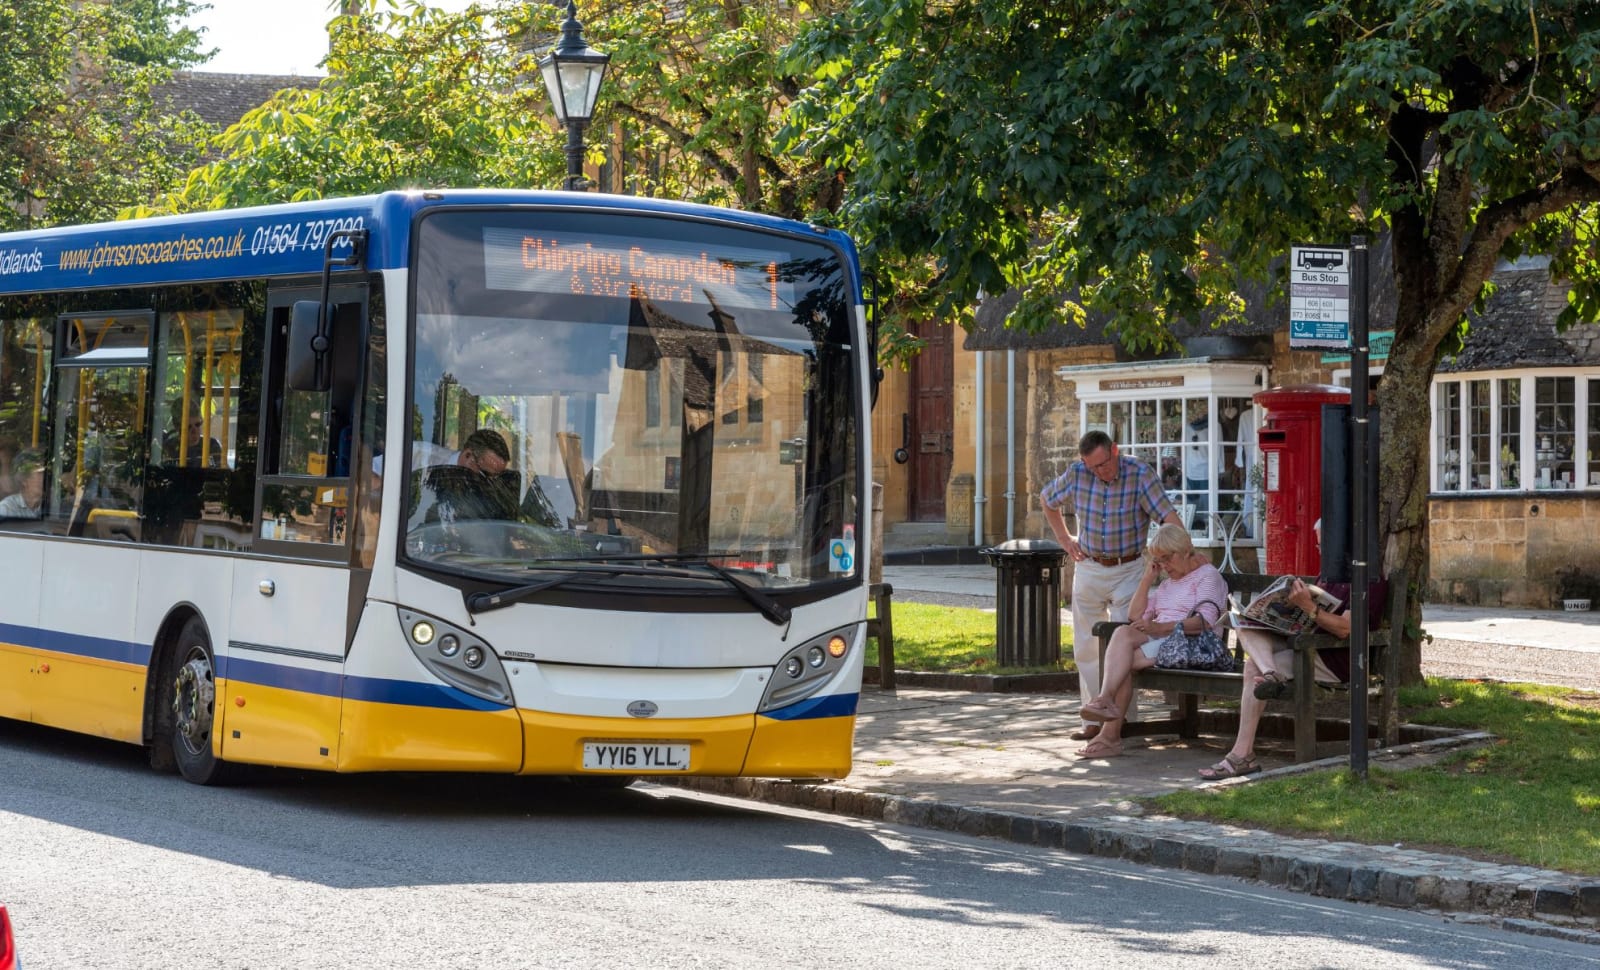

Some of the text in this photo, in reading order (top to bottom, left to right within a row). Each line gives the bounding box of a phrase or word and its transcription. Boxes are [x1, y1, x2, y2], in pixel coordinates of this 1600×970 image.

[59, 228, 246, 275] www.johnsonscoaches.co.uk
[251, 222, 302, 256] 01564
[521, 236, 736, 286] Chipping Campden
[571, 275, 693, 304] & Stratford
[766, 260, 777, 309] 1
[1302, 272, 1339, 284] Bus Stop
[595, 746, 678, 767] YY16 YLL
